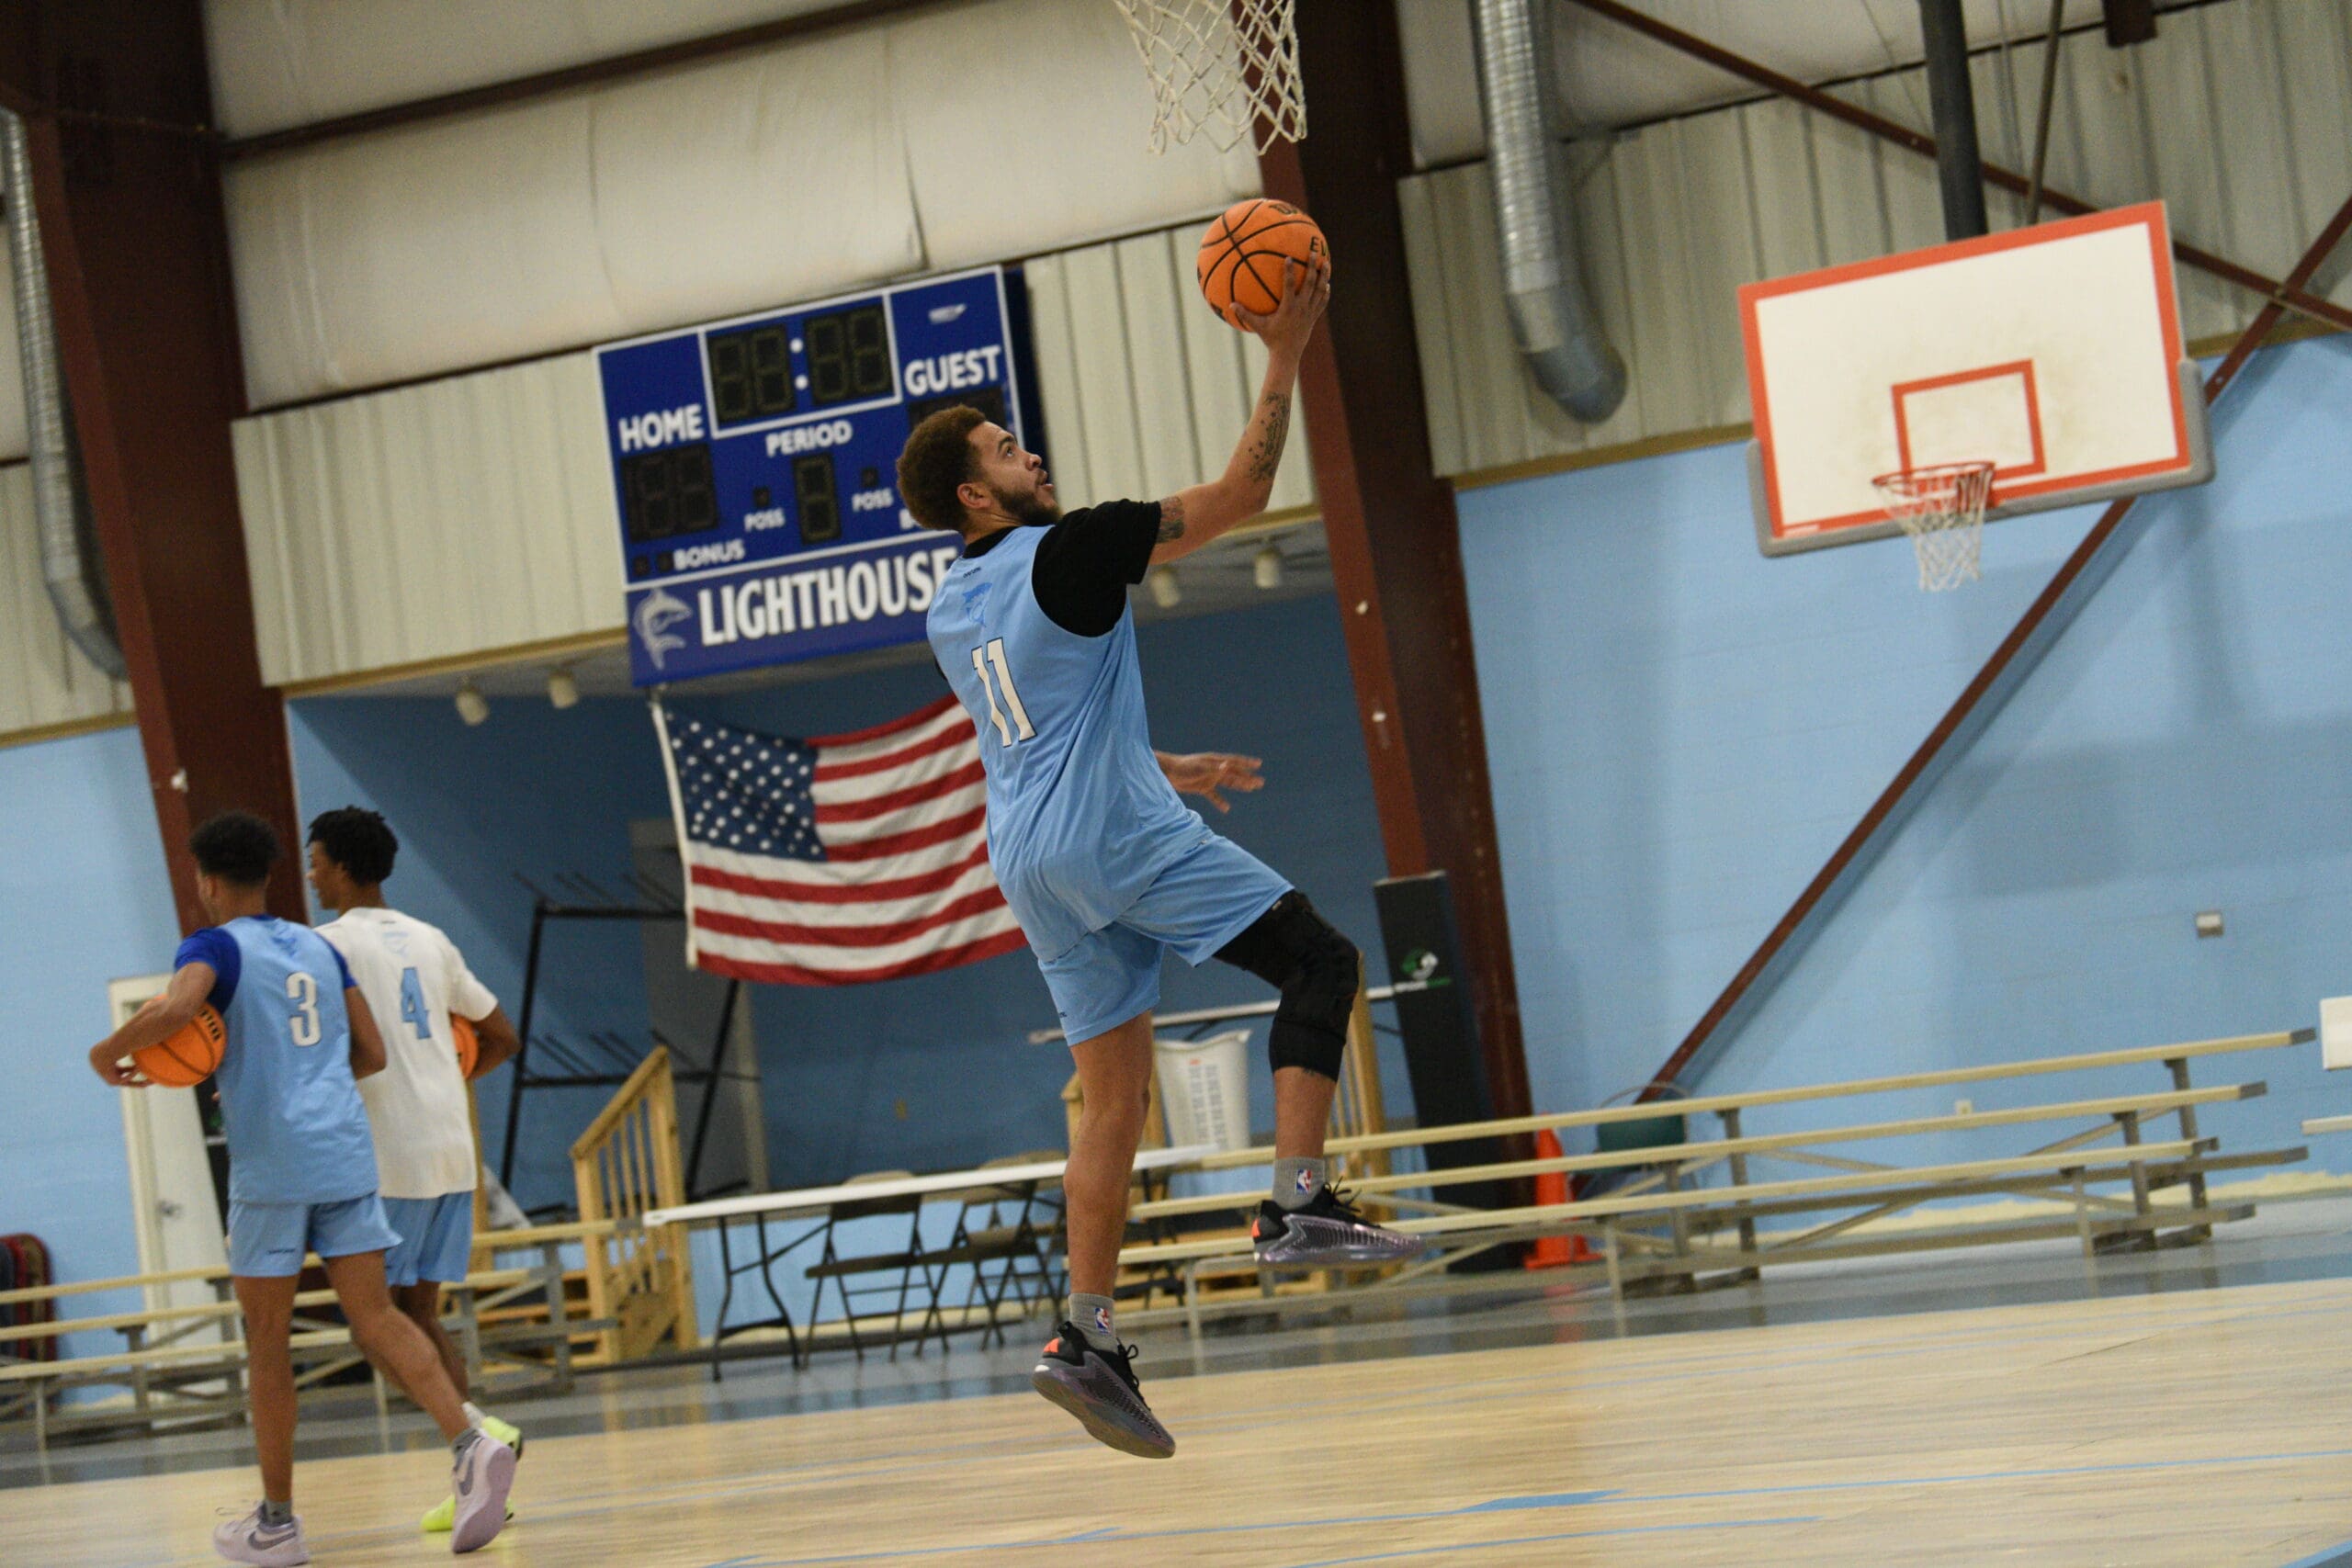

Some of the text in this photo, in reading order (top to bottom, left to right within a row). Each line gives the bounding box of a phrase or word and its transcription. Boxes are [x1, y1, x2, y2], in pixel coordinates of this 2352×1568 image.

[904, 344, 1001, 396] GUEST
[618, 403, 705, 452] HOME
[765, 420, 853, 457] PERIOD
[743, 507, 786, 532] POSS
[852, 488, 894, 512] POSS
[673, 538, 745, 570] BONUS
[971, 637, 1037, 748] 11
[286, 971, 322, 1047] 3
[401, 967, 432, 1040] 4
